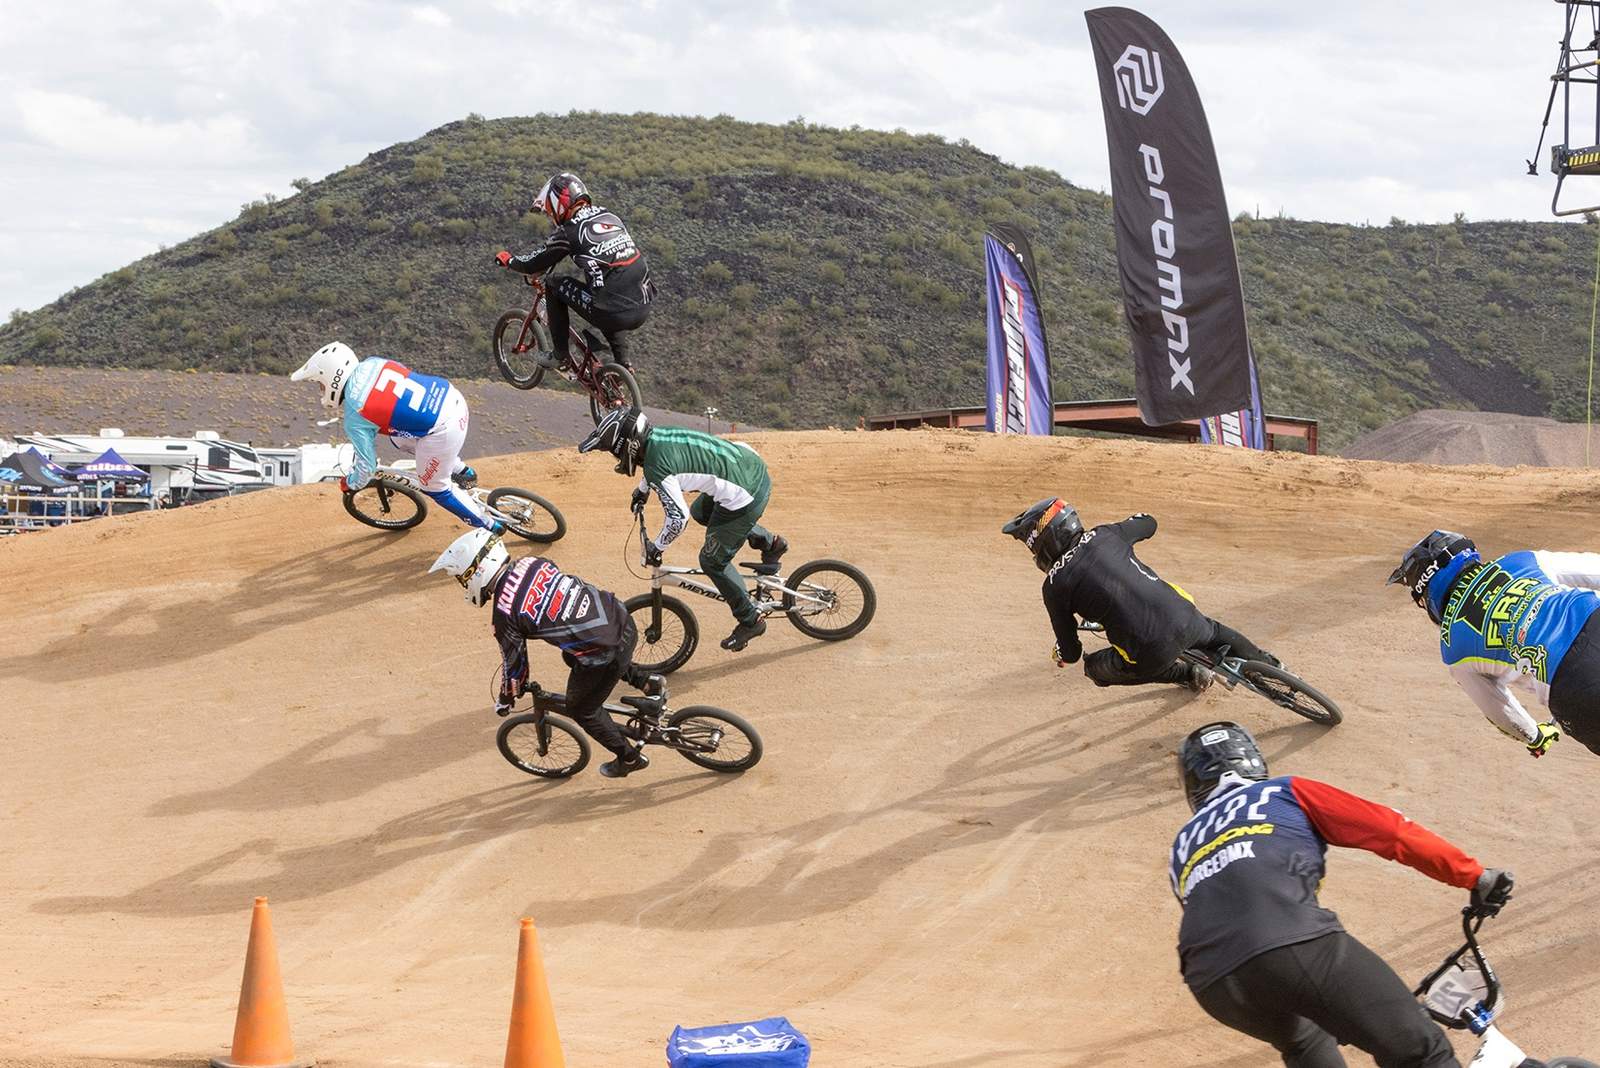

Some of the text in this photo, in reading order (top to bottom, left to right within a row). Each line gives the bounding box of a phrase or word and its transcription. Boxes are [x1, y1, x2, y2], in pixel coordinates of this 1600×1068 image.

[587, 259, 605, 288] ELITE
[374, 368, 427, 412] 3
[678, 580, 726, 603] MEYBO
[1414, 560, 1440, 595] OAKLEY
